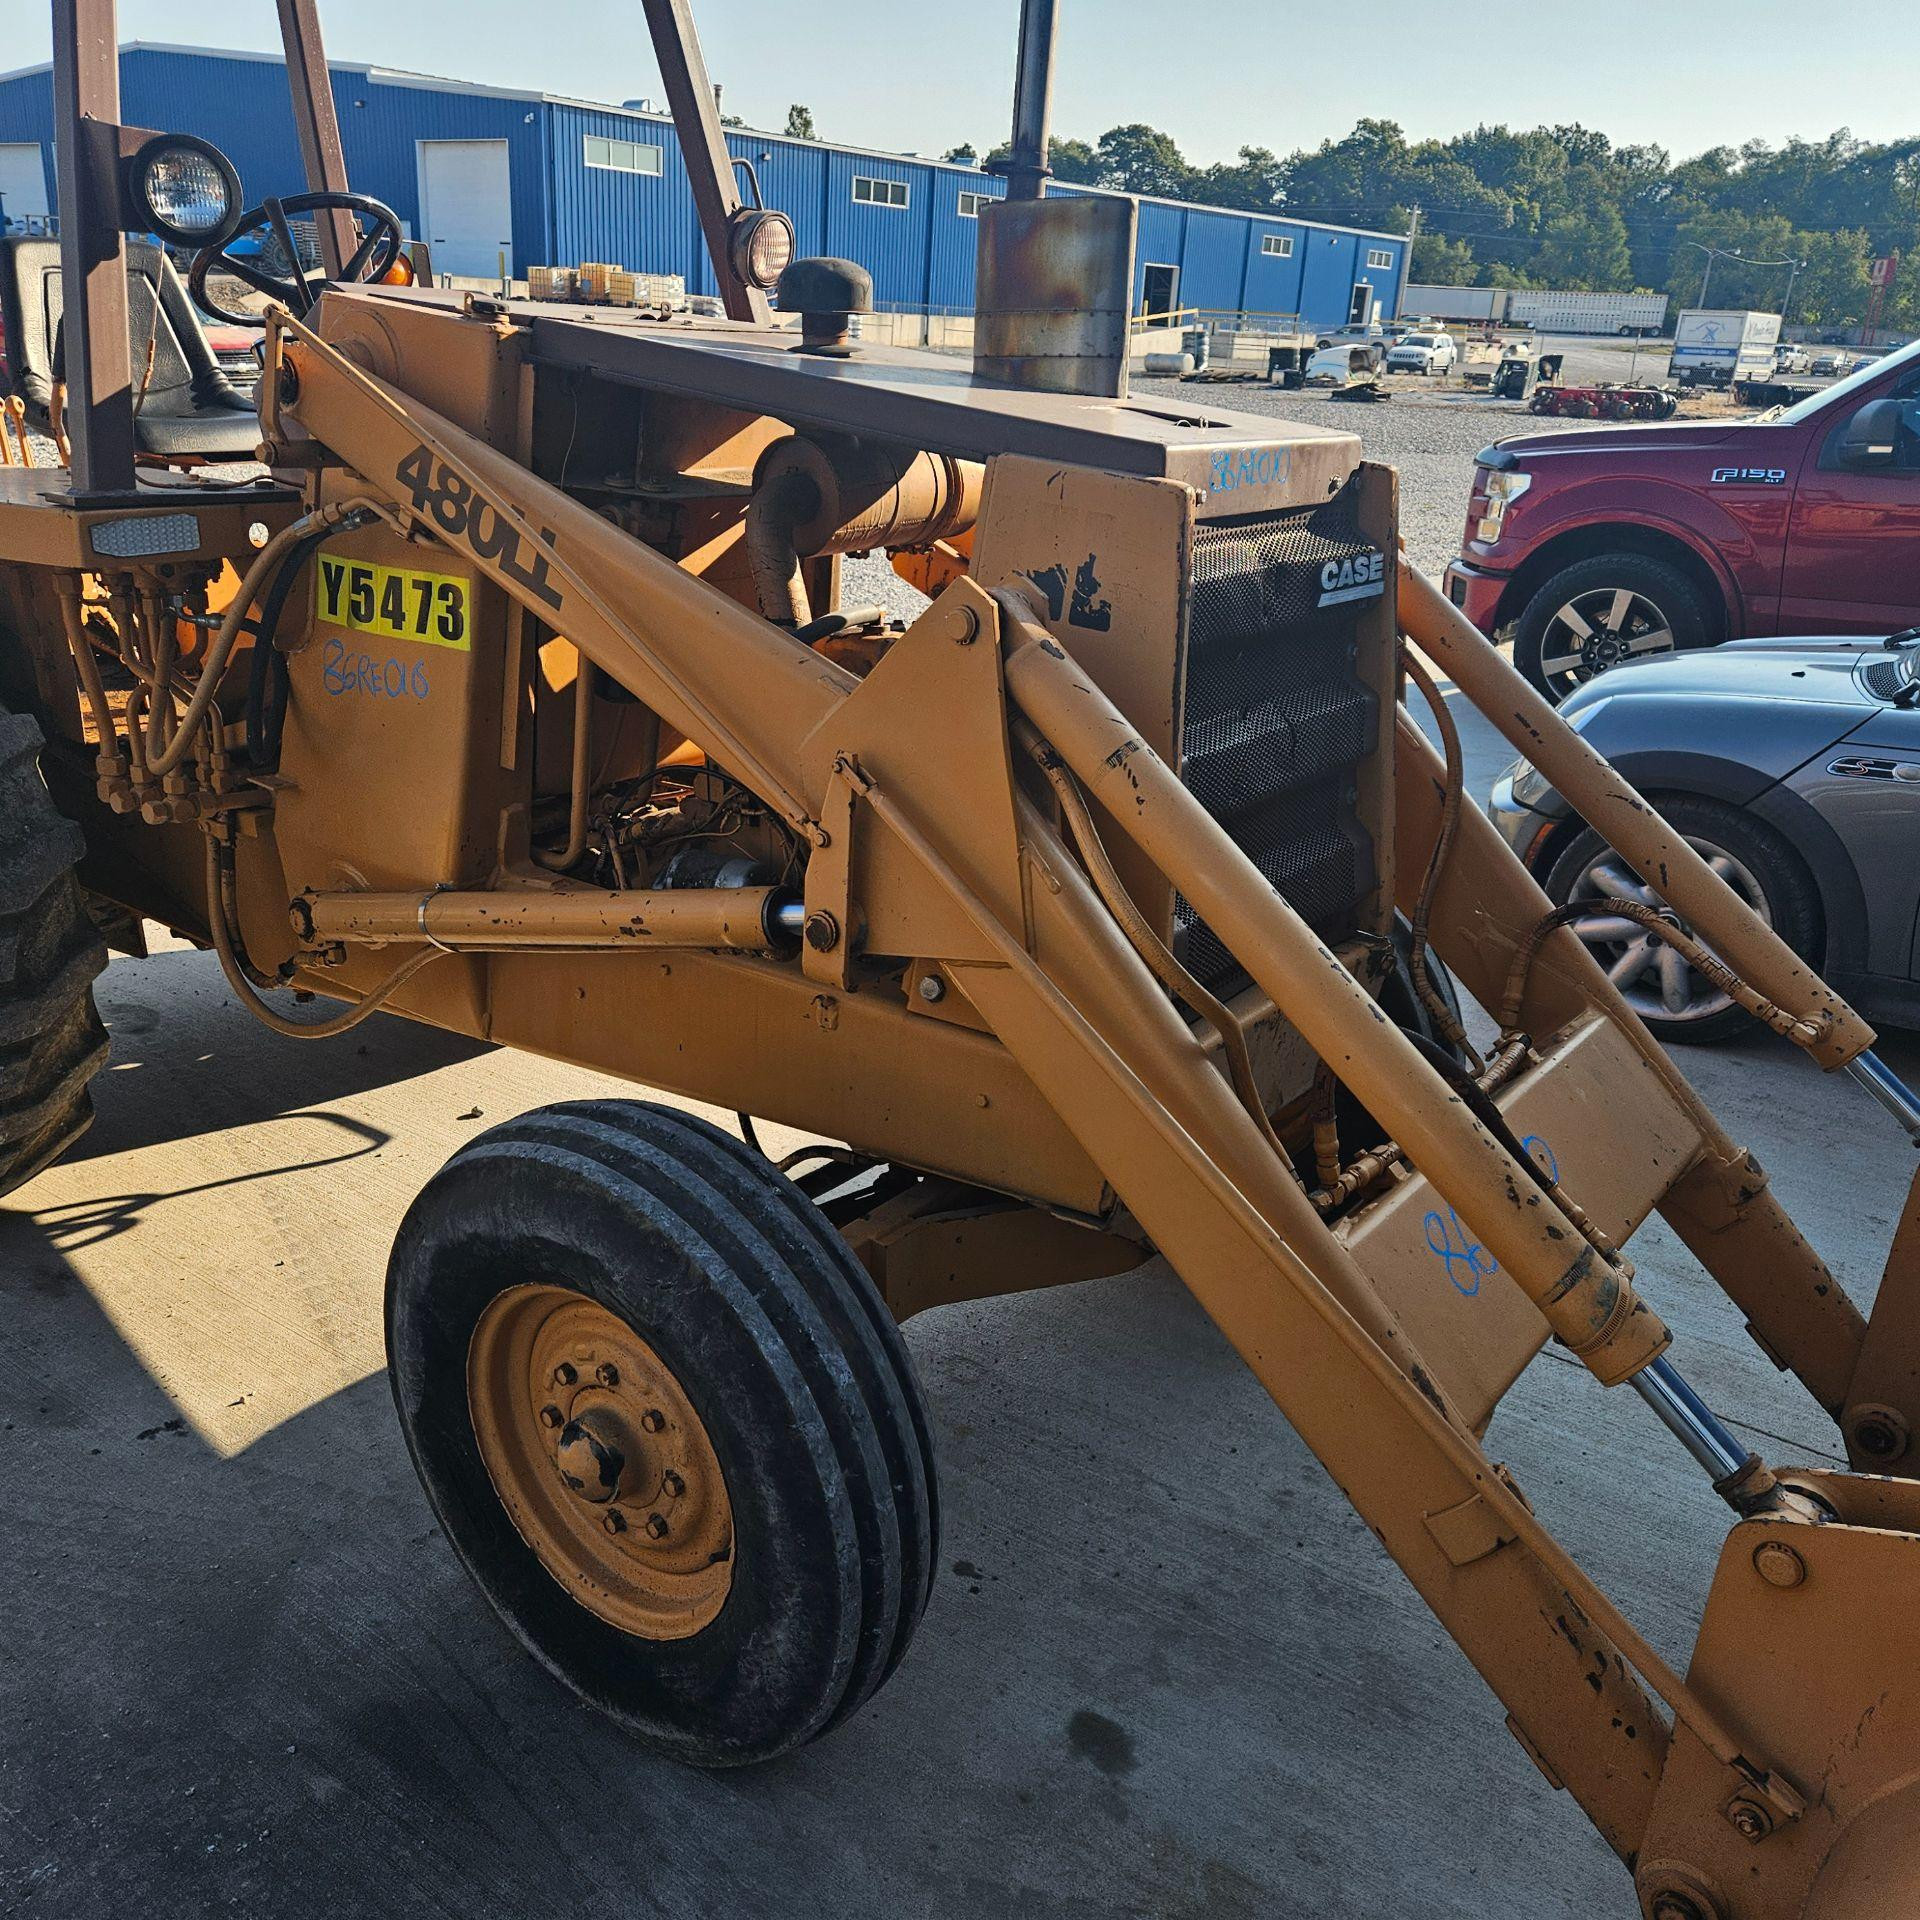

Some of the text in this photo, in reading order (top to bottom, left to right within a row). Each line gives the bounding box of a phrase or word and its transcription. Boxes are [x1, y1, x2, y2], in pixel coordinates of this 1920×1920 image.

[395, 444, 564, 612] 480LL
[321, 560, 465, 642] Y5473
[1321, 553, 1384, 590] CASE
